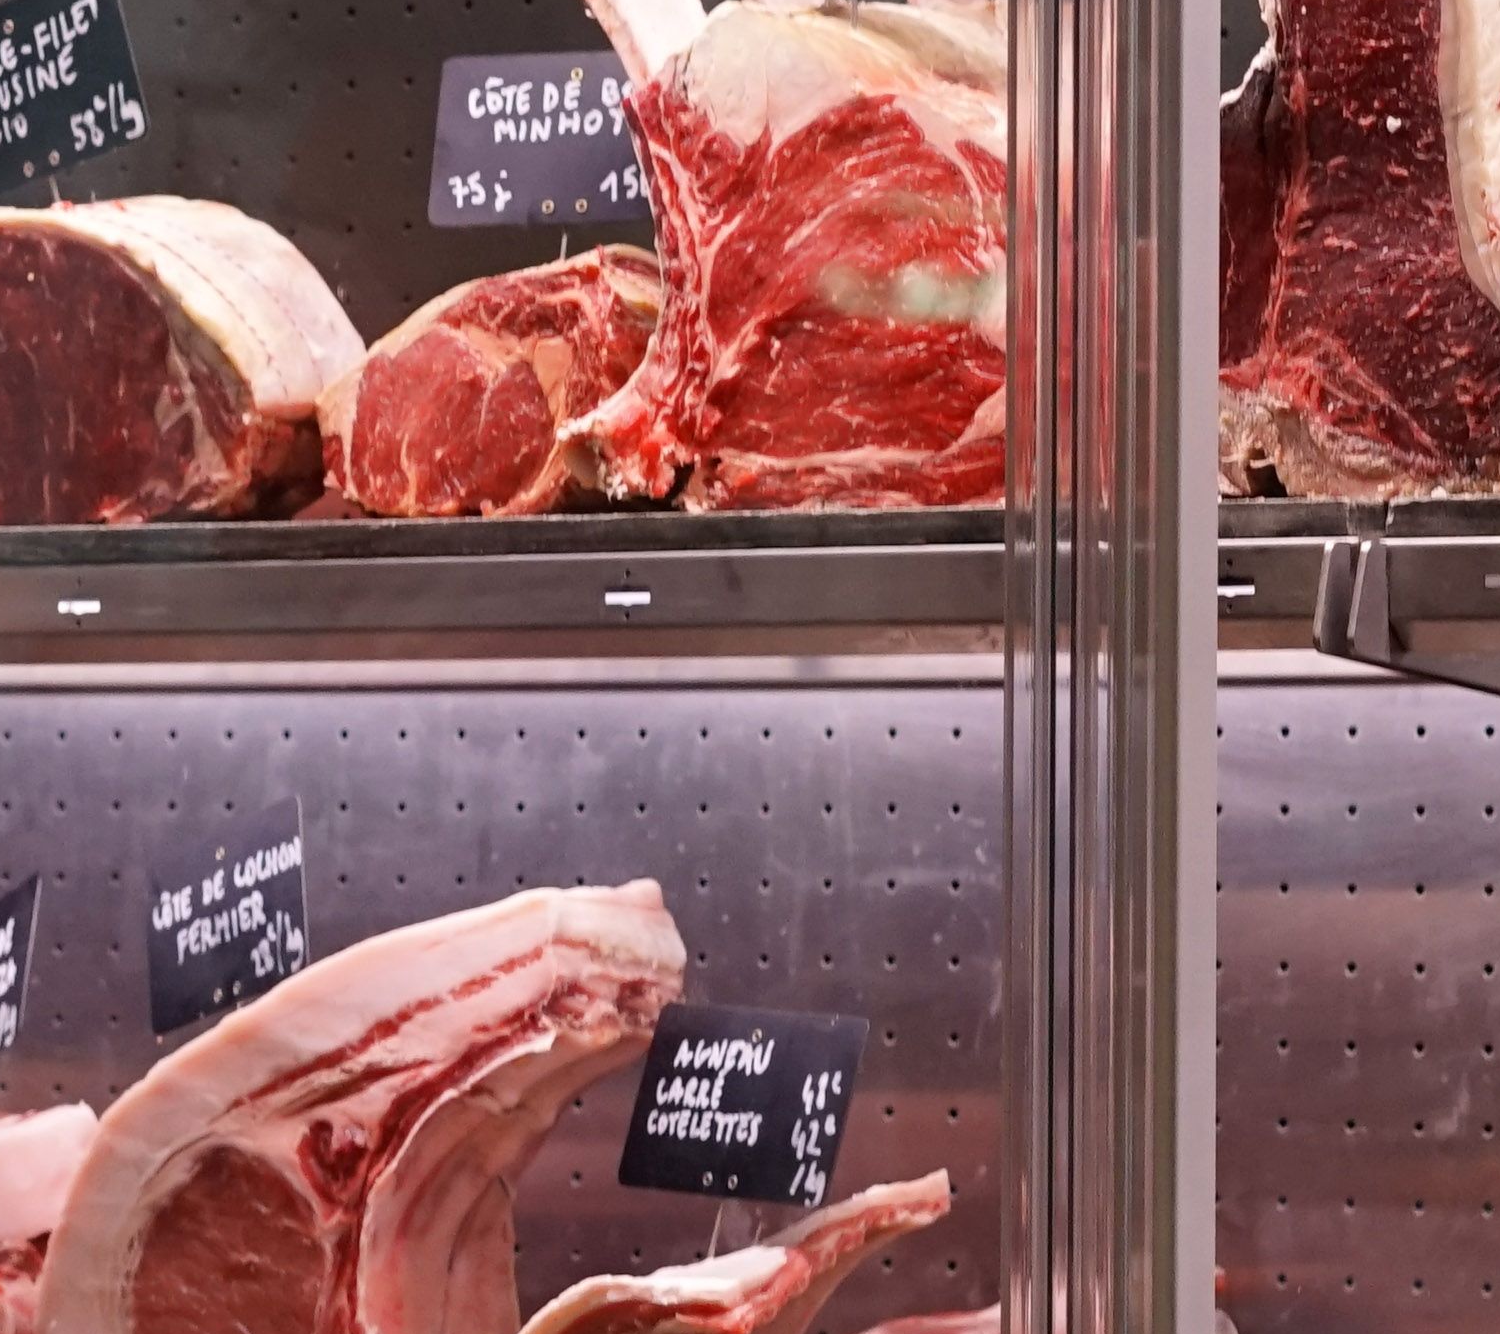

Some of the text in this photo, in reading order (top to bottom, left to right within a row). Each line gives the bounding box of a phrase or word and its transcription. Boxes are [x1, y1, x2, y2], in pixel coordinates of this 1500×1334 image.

[468, 76, 533, 119] CÔTE
[543, 80, 581, 116] DE
[152, 835, 302, 931] CÔTE DE COCHON
[177, 890, 266, 965] FERMIER
[673, 1038, 775, 1077] AGNEAU
